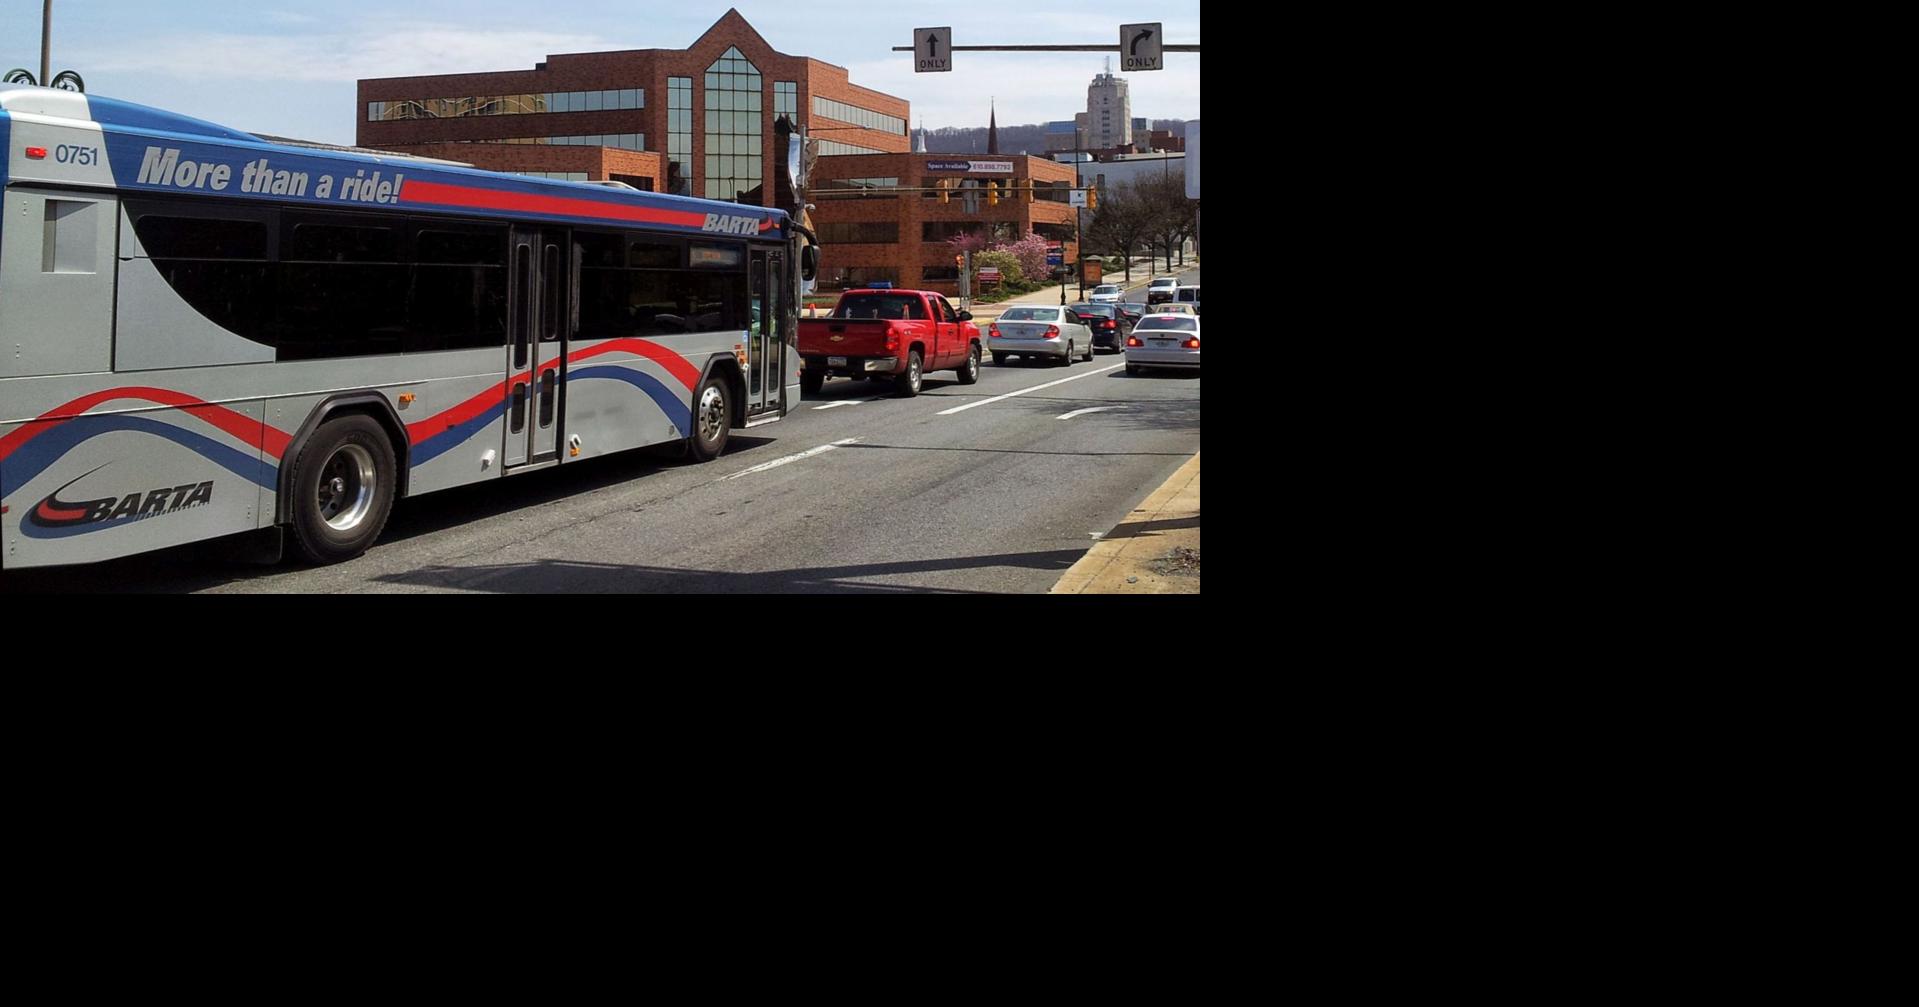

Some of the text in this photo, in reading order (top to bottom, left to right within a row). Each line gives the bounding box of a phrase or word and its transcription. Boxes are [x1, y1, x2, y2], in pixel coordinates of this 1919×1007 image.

[920, 59, 946, 69] ONLY
[1127, 57, 1157, 68] ONLY
[55, 144, 98, 166] 0751
[137, 146, 404, 204] More than a ride!
[702, 213, 760, 235] BARTA
[87, 480, 214, 521] BARTA
